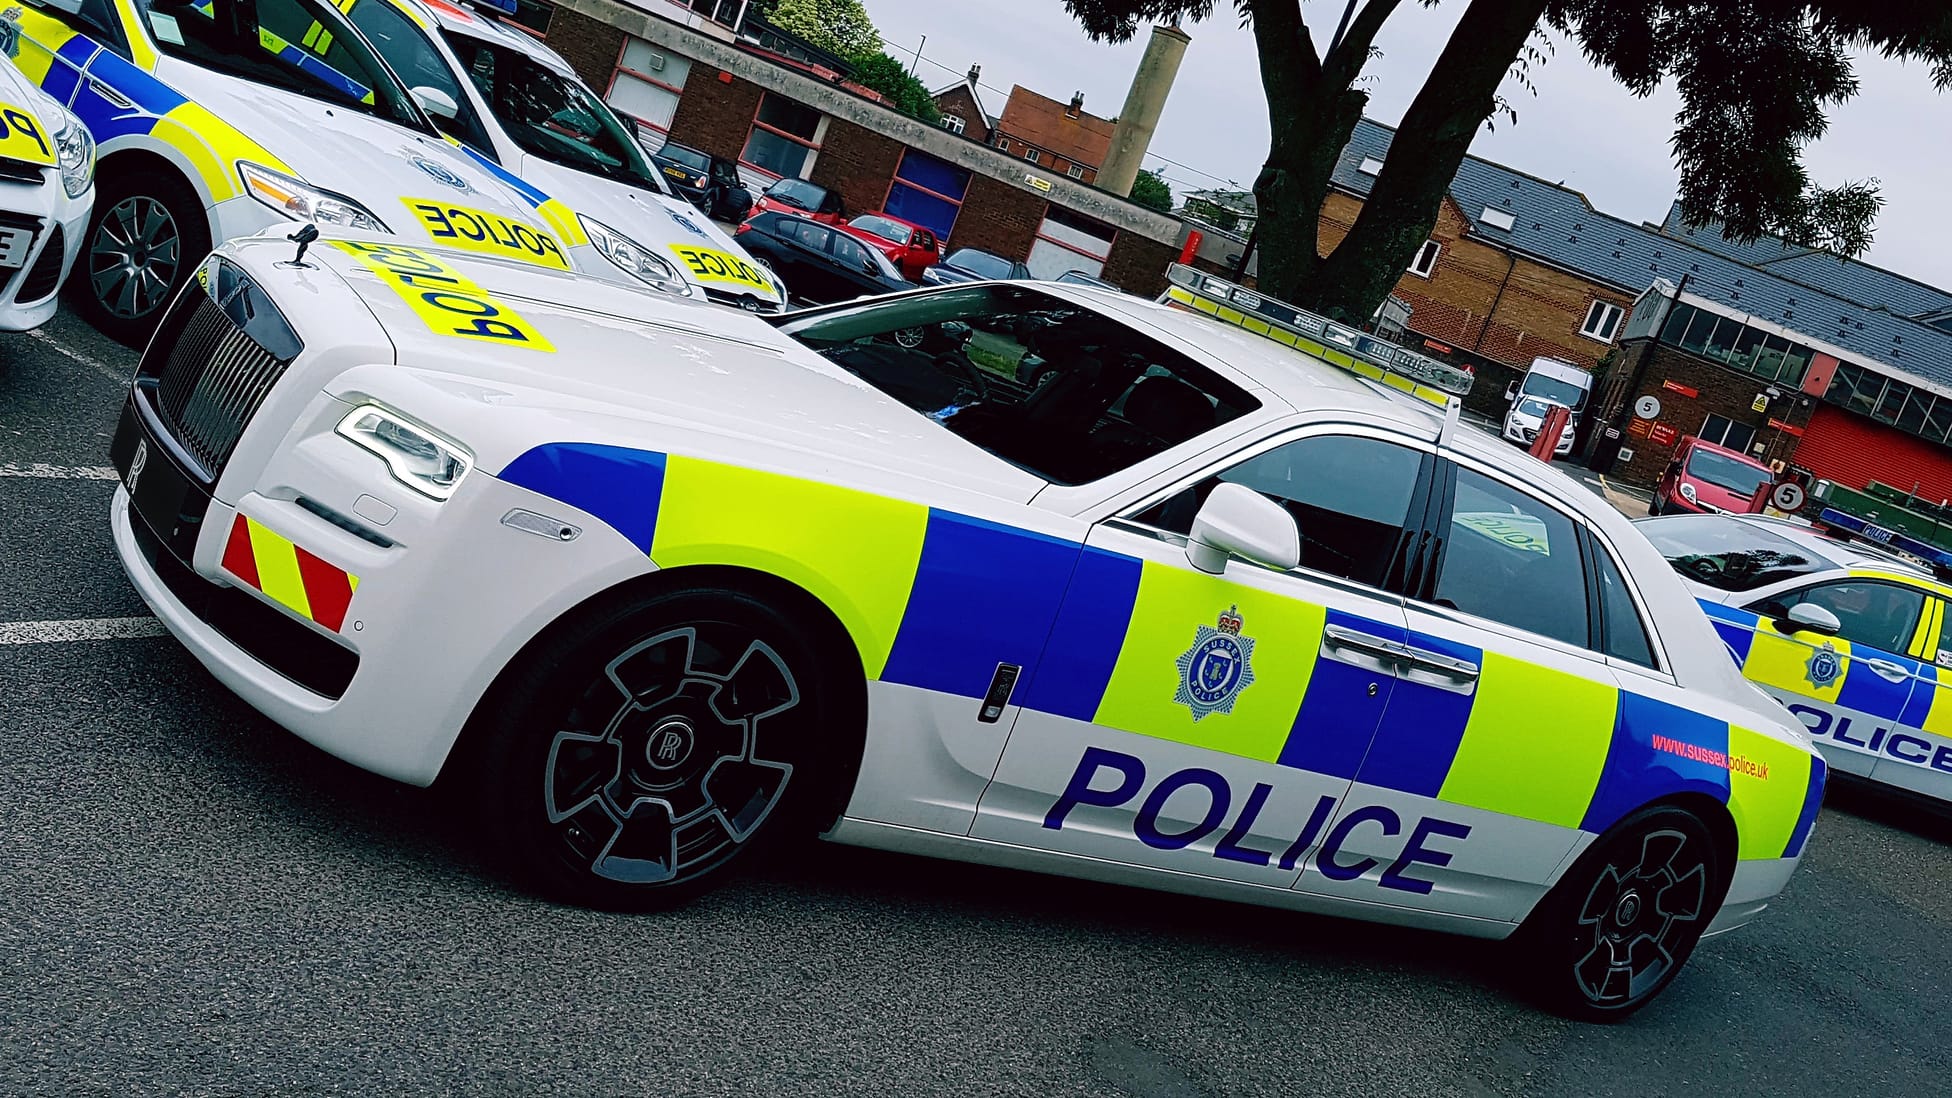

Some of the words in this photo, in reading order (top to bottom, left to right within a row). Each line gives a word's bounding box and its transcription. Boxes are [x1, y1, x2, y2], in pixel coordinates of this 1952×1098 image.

[1643, 402, 1653, 412] 5
[1780, 487, 1797, 504] 5
[1866, 524, 1892, 543] POLICE
[1203, 639, 1241, 665] SUSSEX
[1191, 680, 1229, 701] POLICE
[1774, 696, 1952, 772] OLICE
[1652, 734, 1769, 780] www.sussex.police.uk
[1041, 746, 1473, 895] POLICE
